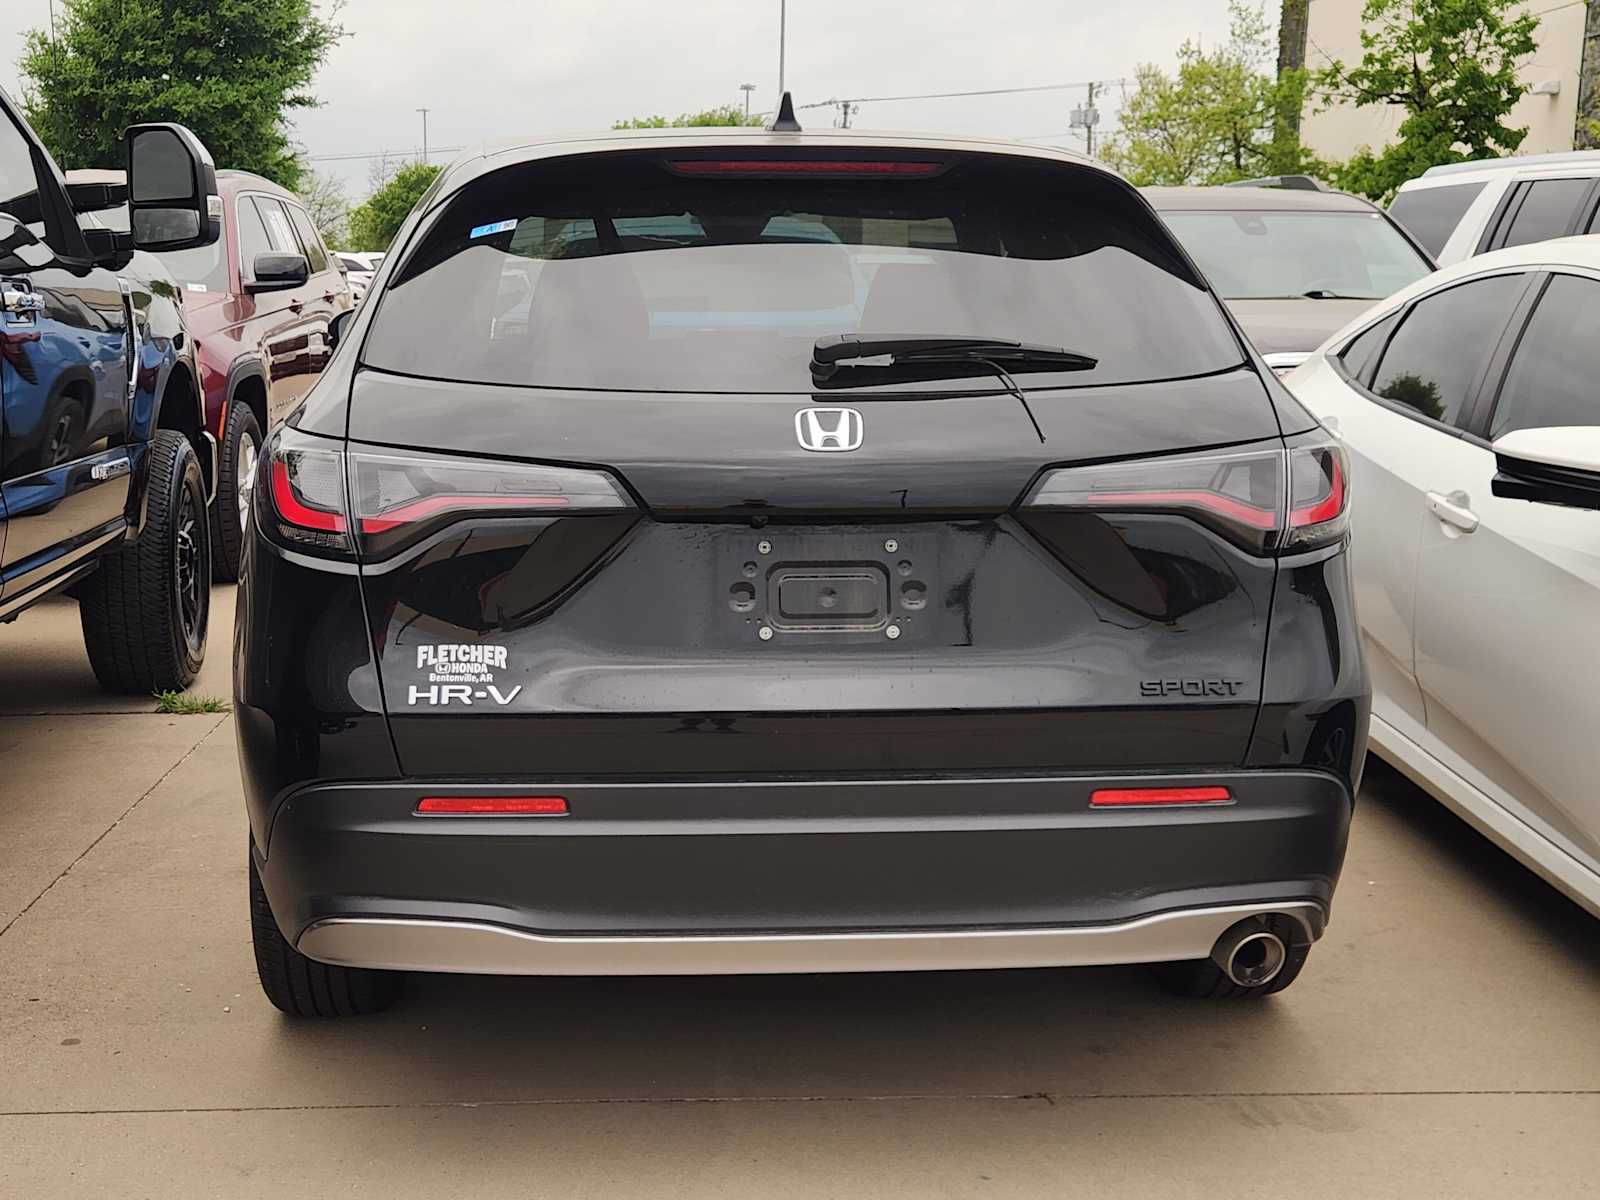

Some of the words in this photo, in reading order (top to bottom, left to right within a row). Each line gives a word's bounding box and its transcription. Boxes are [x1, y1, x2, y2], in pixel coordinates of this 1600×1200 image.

[416, 644, 508, 669] FLETCHER
[451, 662, 489, 674] HONDA
[408, 685, 522, 705] HR-V
[1140, 679, 1244, 697] SPORT
